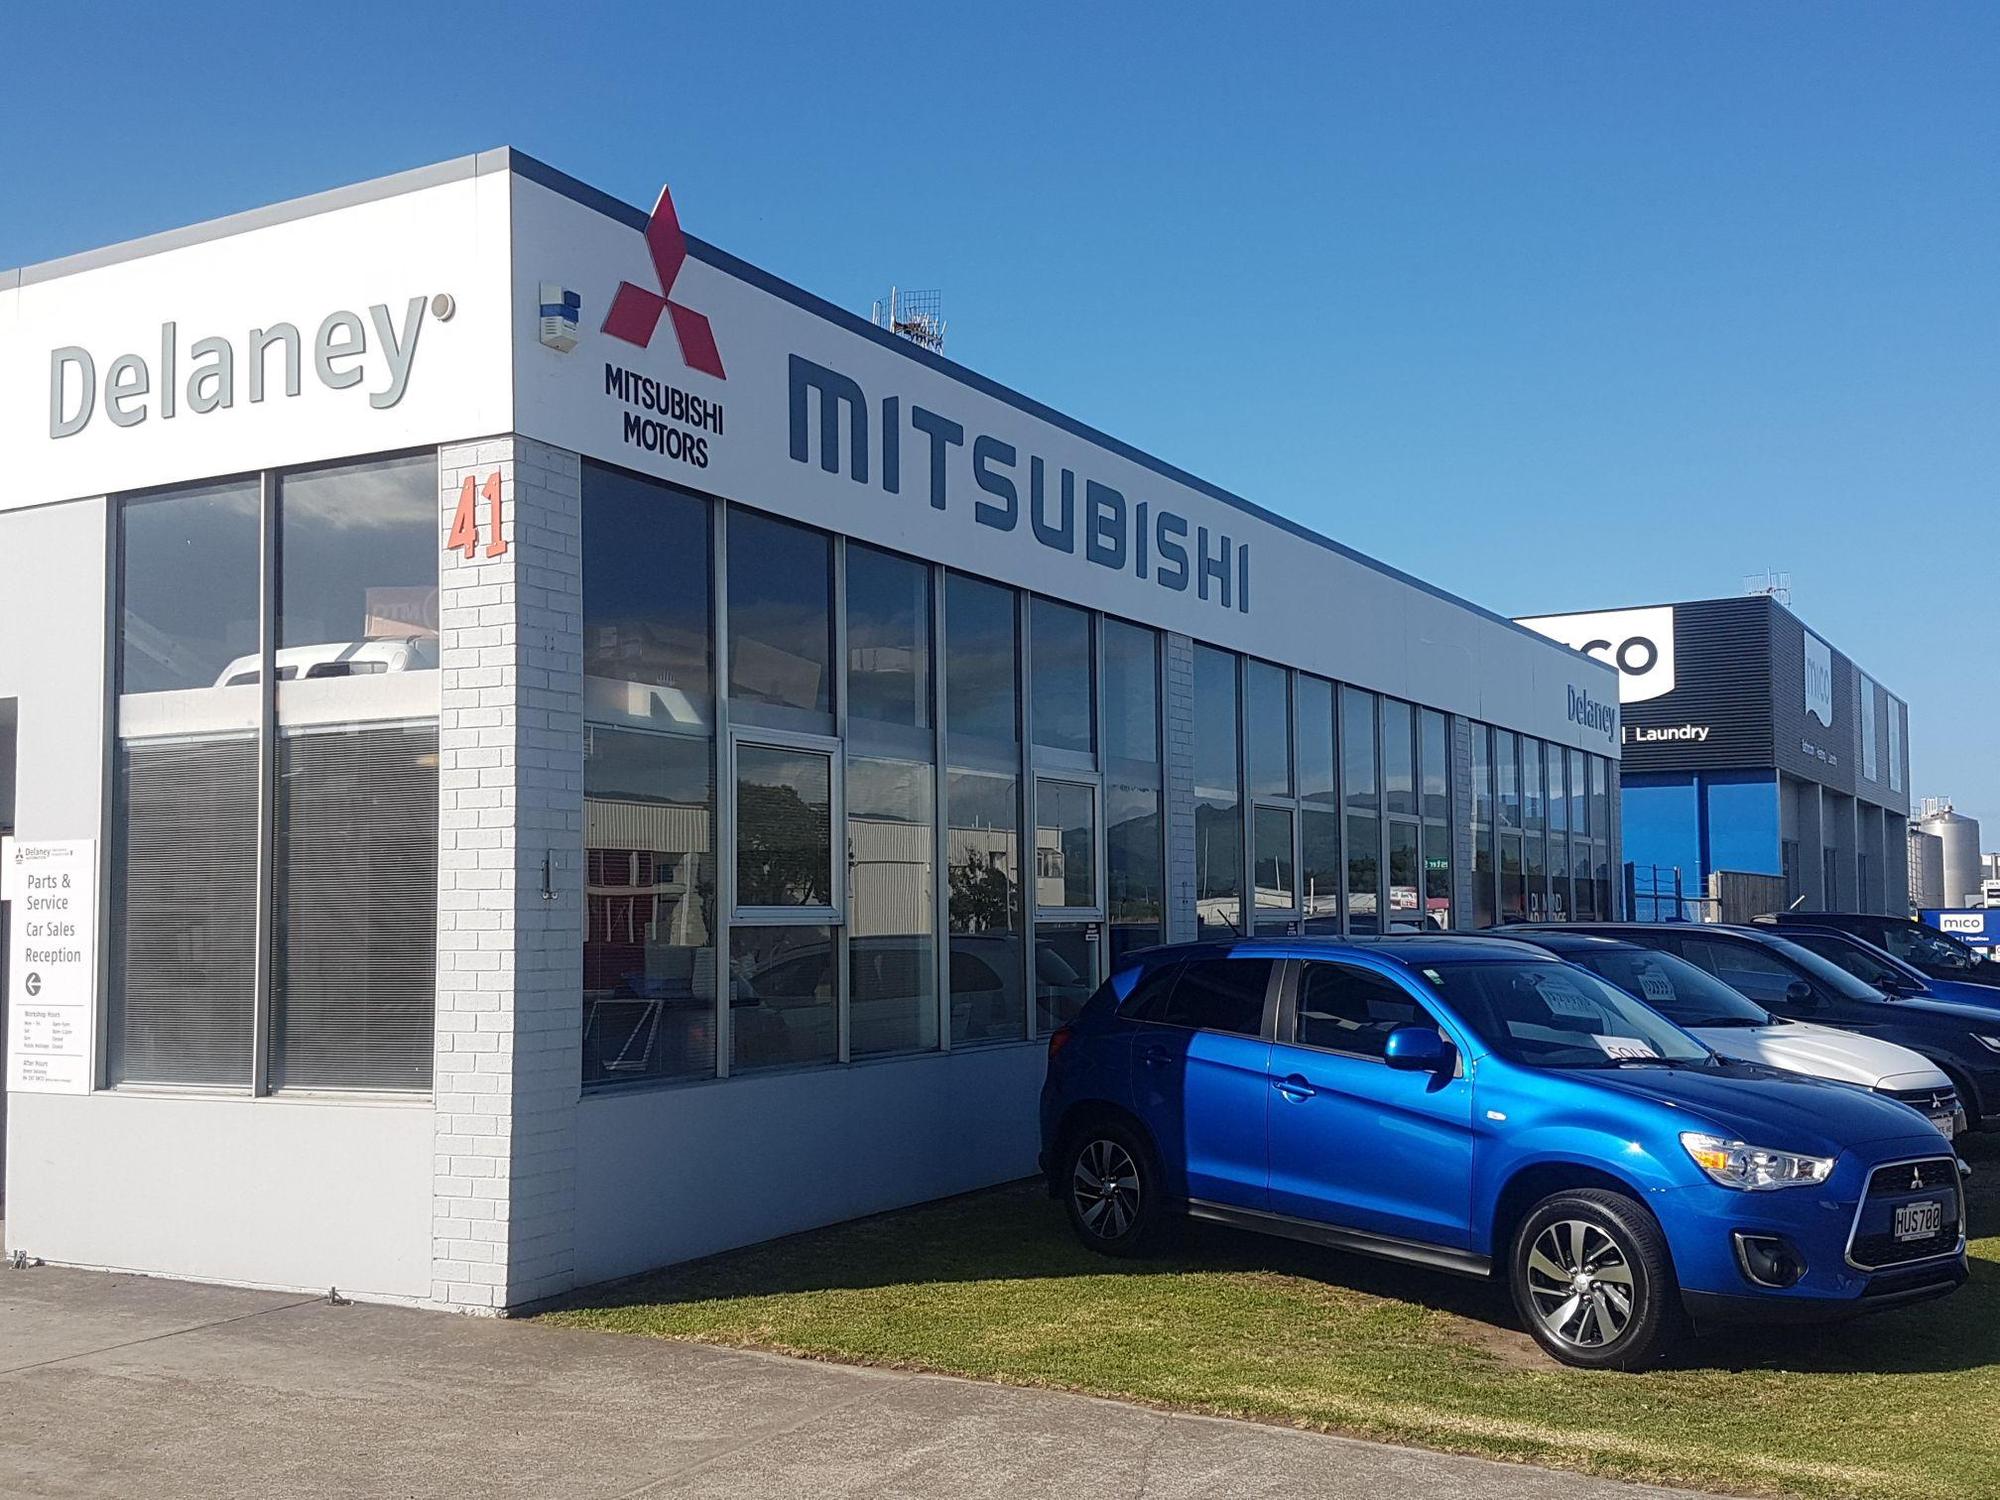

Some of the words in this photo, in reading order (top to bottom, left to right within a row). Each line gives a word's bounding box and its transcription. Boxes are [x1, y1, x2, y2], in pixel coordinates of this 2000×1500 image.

[49, 295, 428, 440] Delaney
[605, 362, 724, 436] MITSUBISHI
[623, 411, 709, 469] MOTORS
[788, 353, 1250, 614] MITSUBISHI
[447, 470, 508, 560] 41
[1567, 683, 1616, 743] Delaney
[1635, 723, 1710, 742] Laundry
[27, 874, 57, 889] Parts
[61, 873, 71, 888] &
[26, 895, 69, 910] Service
[26, 922, 44, 937] Car
[46, 921, 76, 937] Sales
[1943, 919, 1981, 929] mico
[25, 947, 82, 966] Reception
